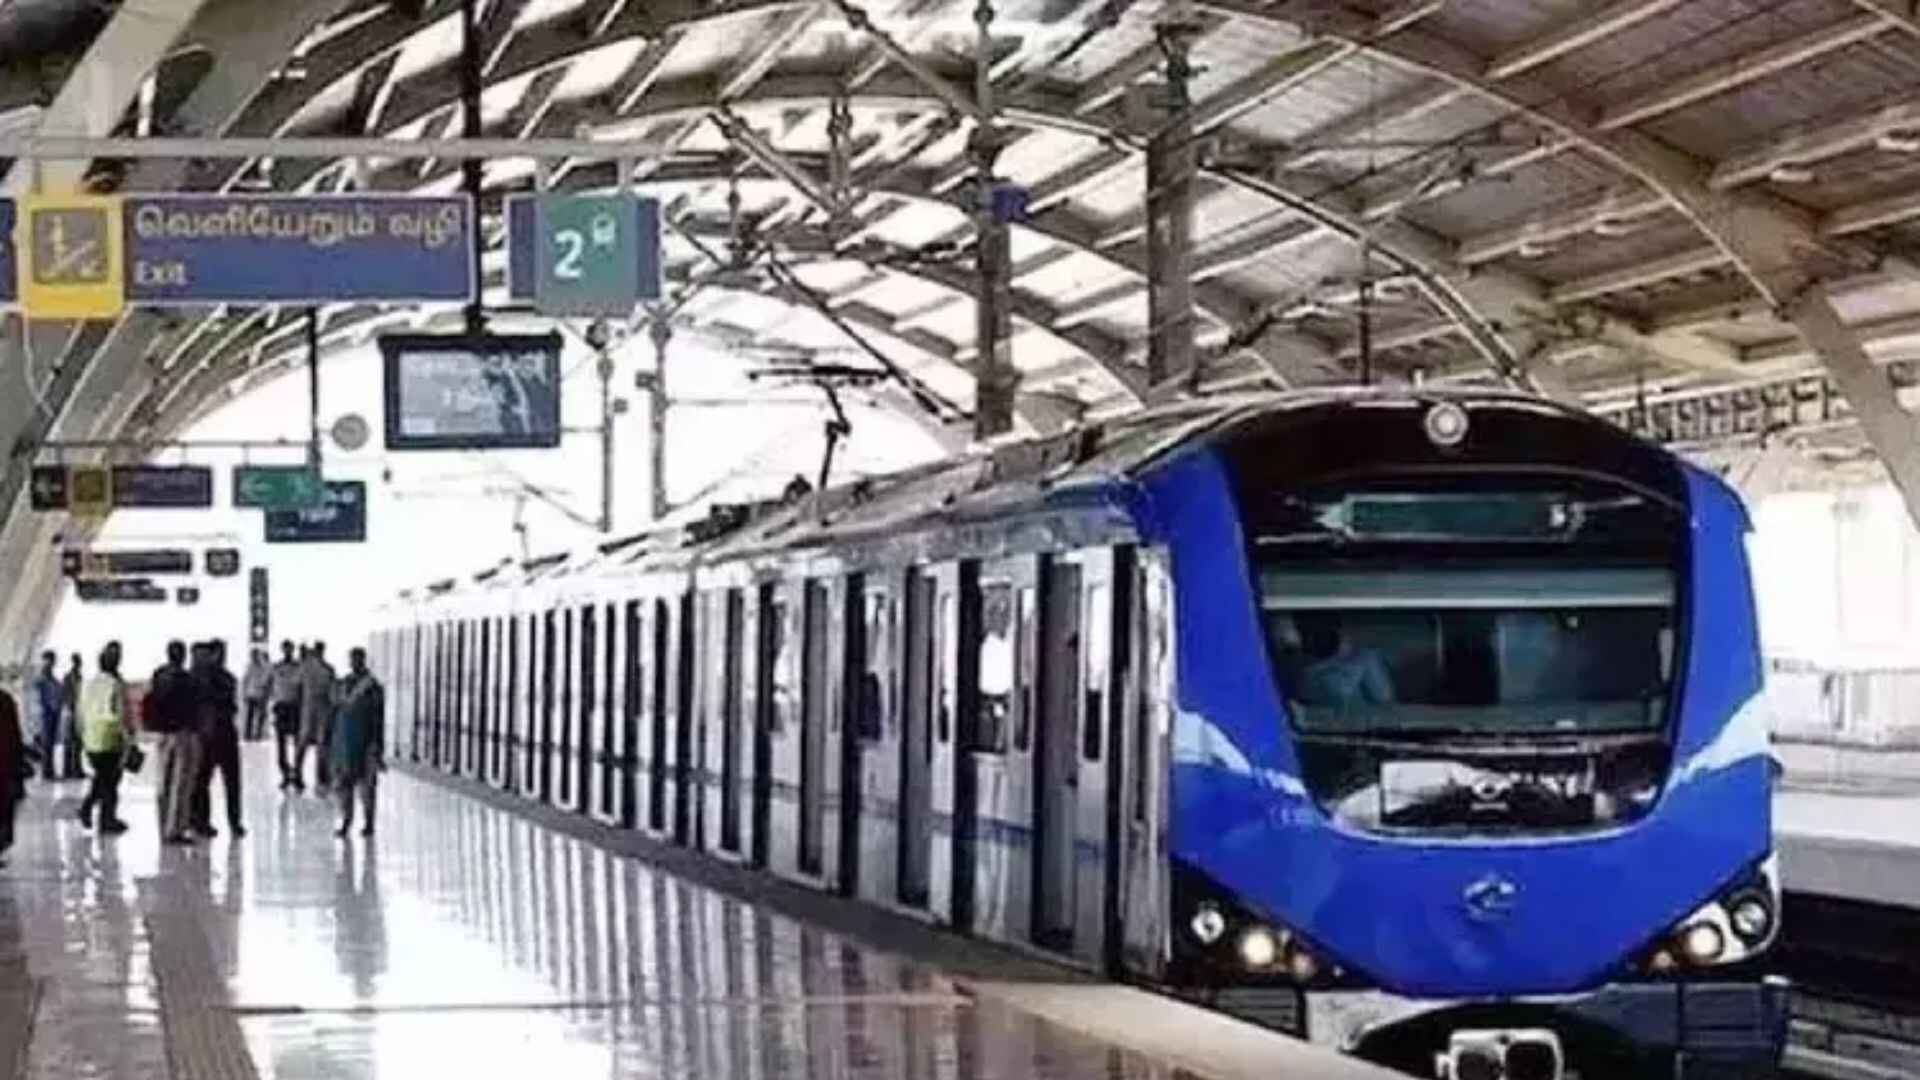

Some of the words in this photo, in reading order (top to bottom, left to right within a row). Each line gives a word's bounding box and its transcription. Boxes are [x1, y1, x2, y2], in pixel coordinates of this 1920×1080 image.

[135, 203, 375, 246] வெளியேறும்
[388, 203, 461, 247] வழி
[134, 259, 188, 285] Exit
[554, 229, 583, 278] 2
